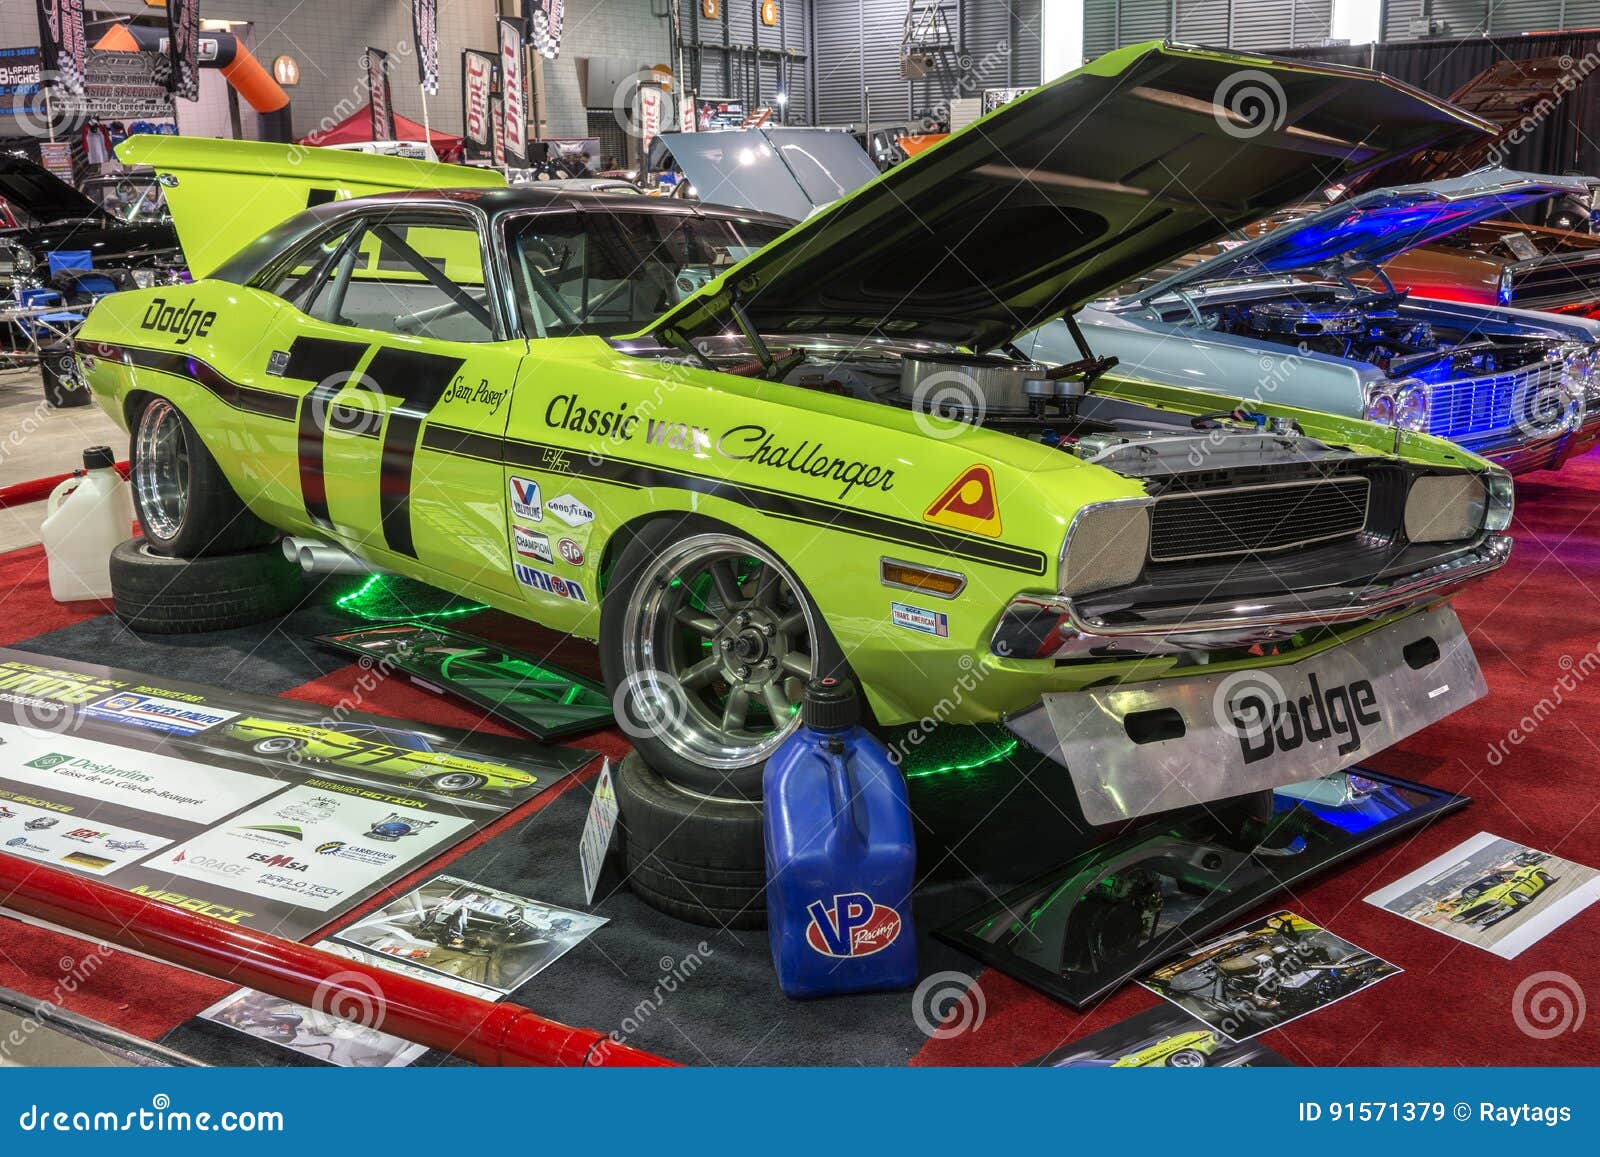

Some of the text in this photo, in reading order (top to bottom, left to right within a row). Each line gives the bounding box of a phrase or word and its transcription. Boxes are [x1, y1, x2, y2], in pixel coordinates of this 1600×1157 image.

[766, 3, 773, 20] 6
[8, 65, 39, 74] LAPPING
[141, 298, 217, 345] Dodge
[444, 375, 508, 415] Sam Posey
[285, 336, 467, 560] 77
[545, 394, 896, 500] Classic wax Challenger
[543, 448, 570, 471] R/T
[514, 500, 541, 520] VALVOLINE
[516, 535, 550, 555] CHAMPION
[561, 542, 580, 560] STP
[893, 610, 909, 621] TRANS
[911, 614, 935, 627] AMERICAN
[1229, 672, 1382, 764] Dodge
[53, 767, 86, 779] Caisse
[85, 773, 101, 782] de
[100, 776, 115, 786] La
[69, 758, 153, 783] Desjardins
[12, 795, 76, 813] BRONZE
[360, 790, 428, 808] ACTION
[348, 846, 397, 860] CARREFOUR
[190, 855, 250, 877] ORAGE
[307, 884, 345, 897] TECH
[807, 892, 875, 957] VP
[854, 917, 900, 949] Racing
